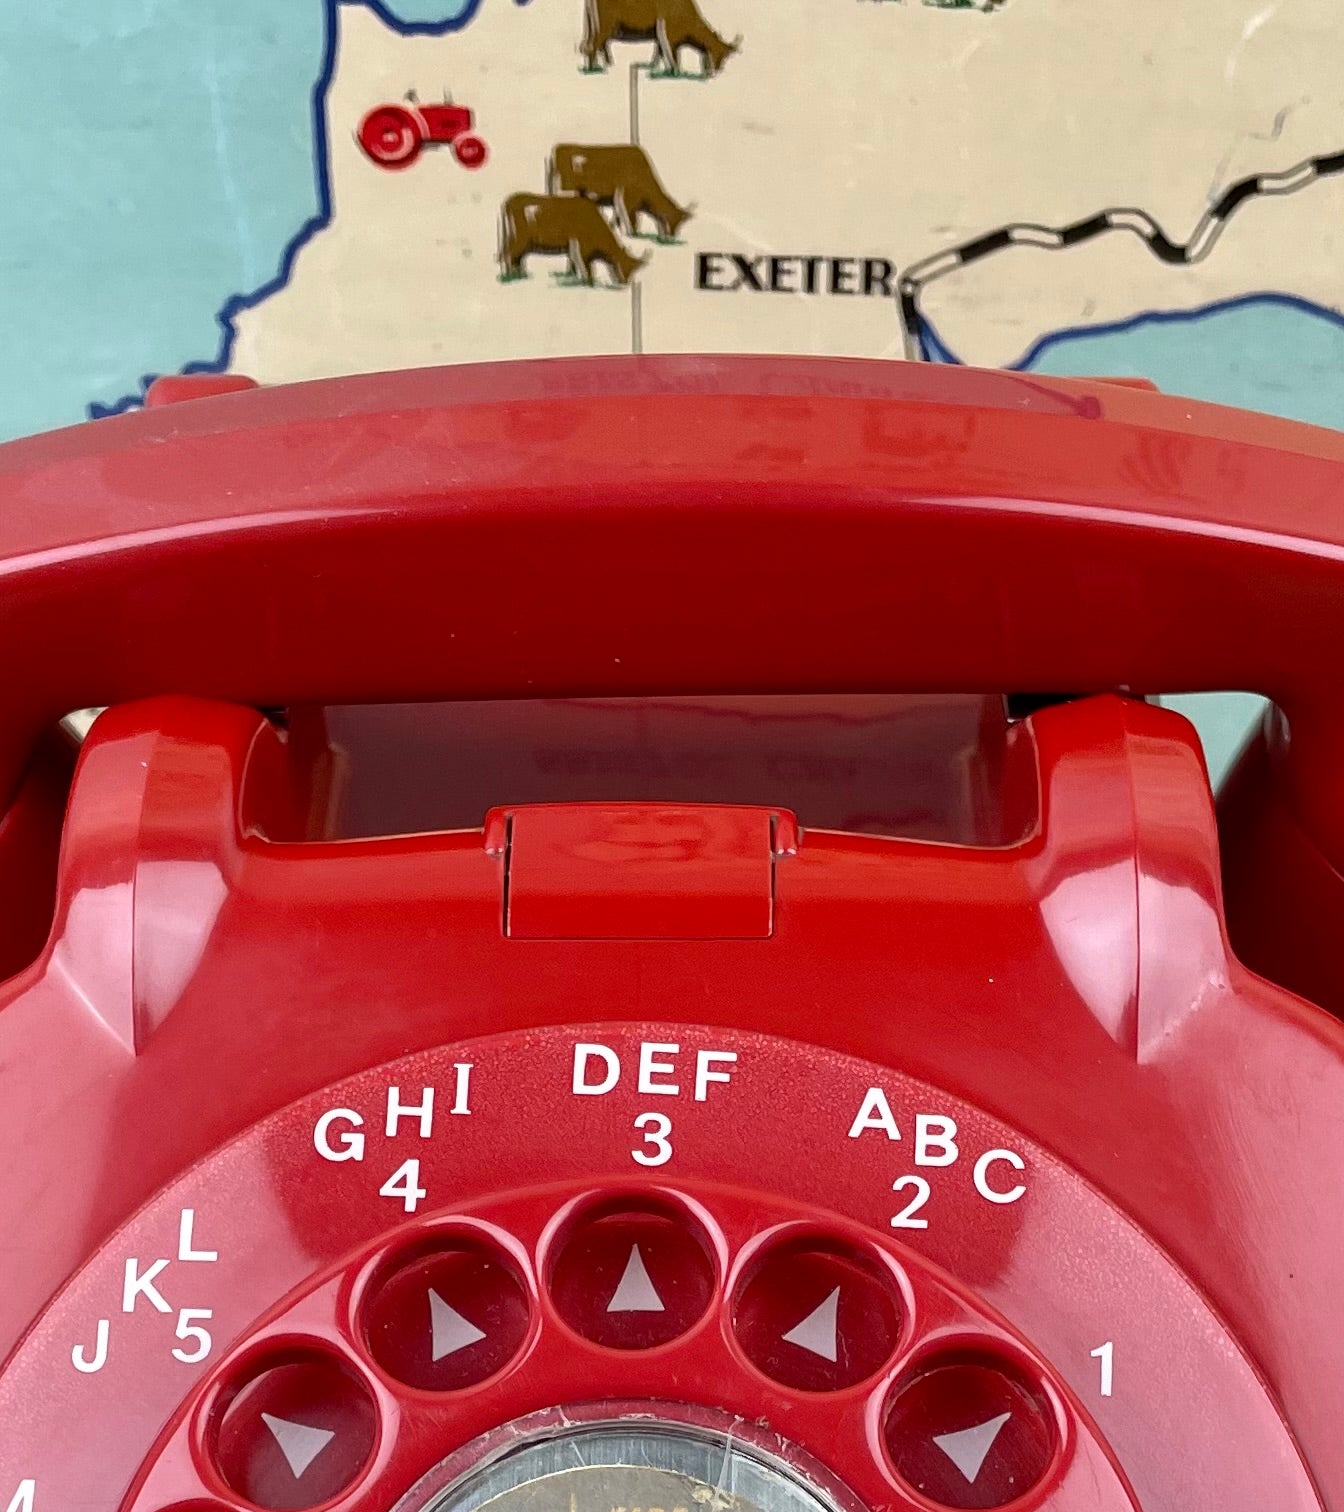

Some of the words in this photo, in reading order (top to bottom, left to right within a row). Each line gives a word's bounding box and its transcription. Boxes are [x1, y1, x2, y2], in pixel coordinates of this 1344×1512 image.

[694, 252, 897, 296] EXETER
[572, 1041, 738, 1102] DEF
[631, 1111, 673, 1167] 3
[378, 1158, 427, 1213] 4
[890, 1175, 930, 1230] 2
[171, 1307, 213, 1364] 5
[1088, 1341, 1115, 1398] 1
